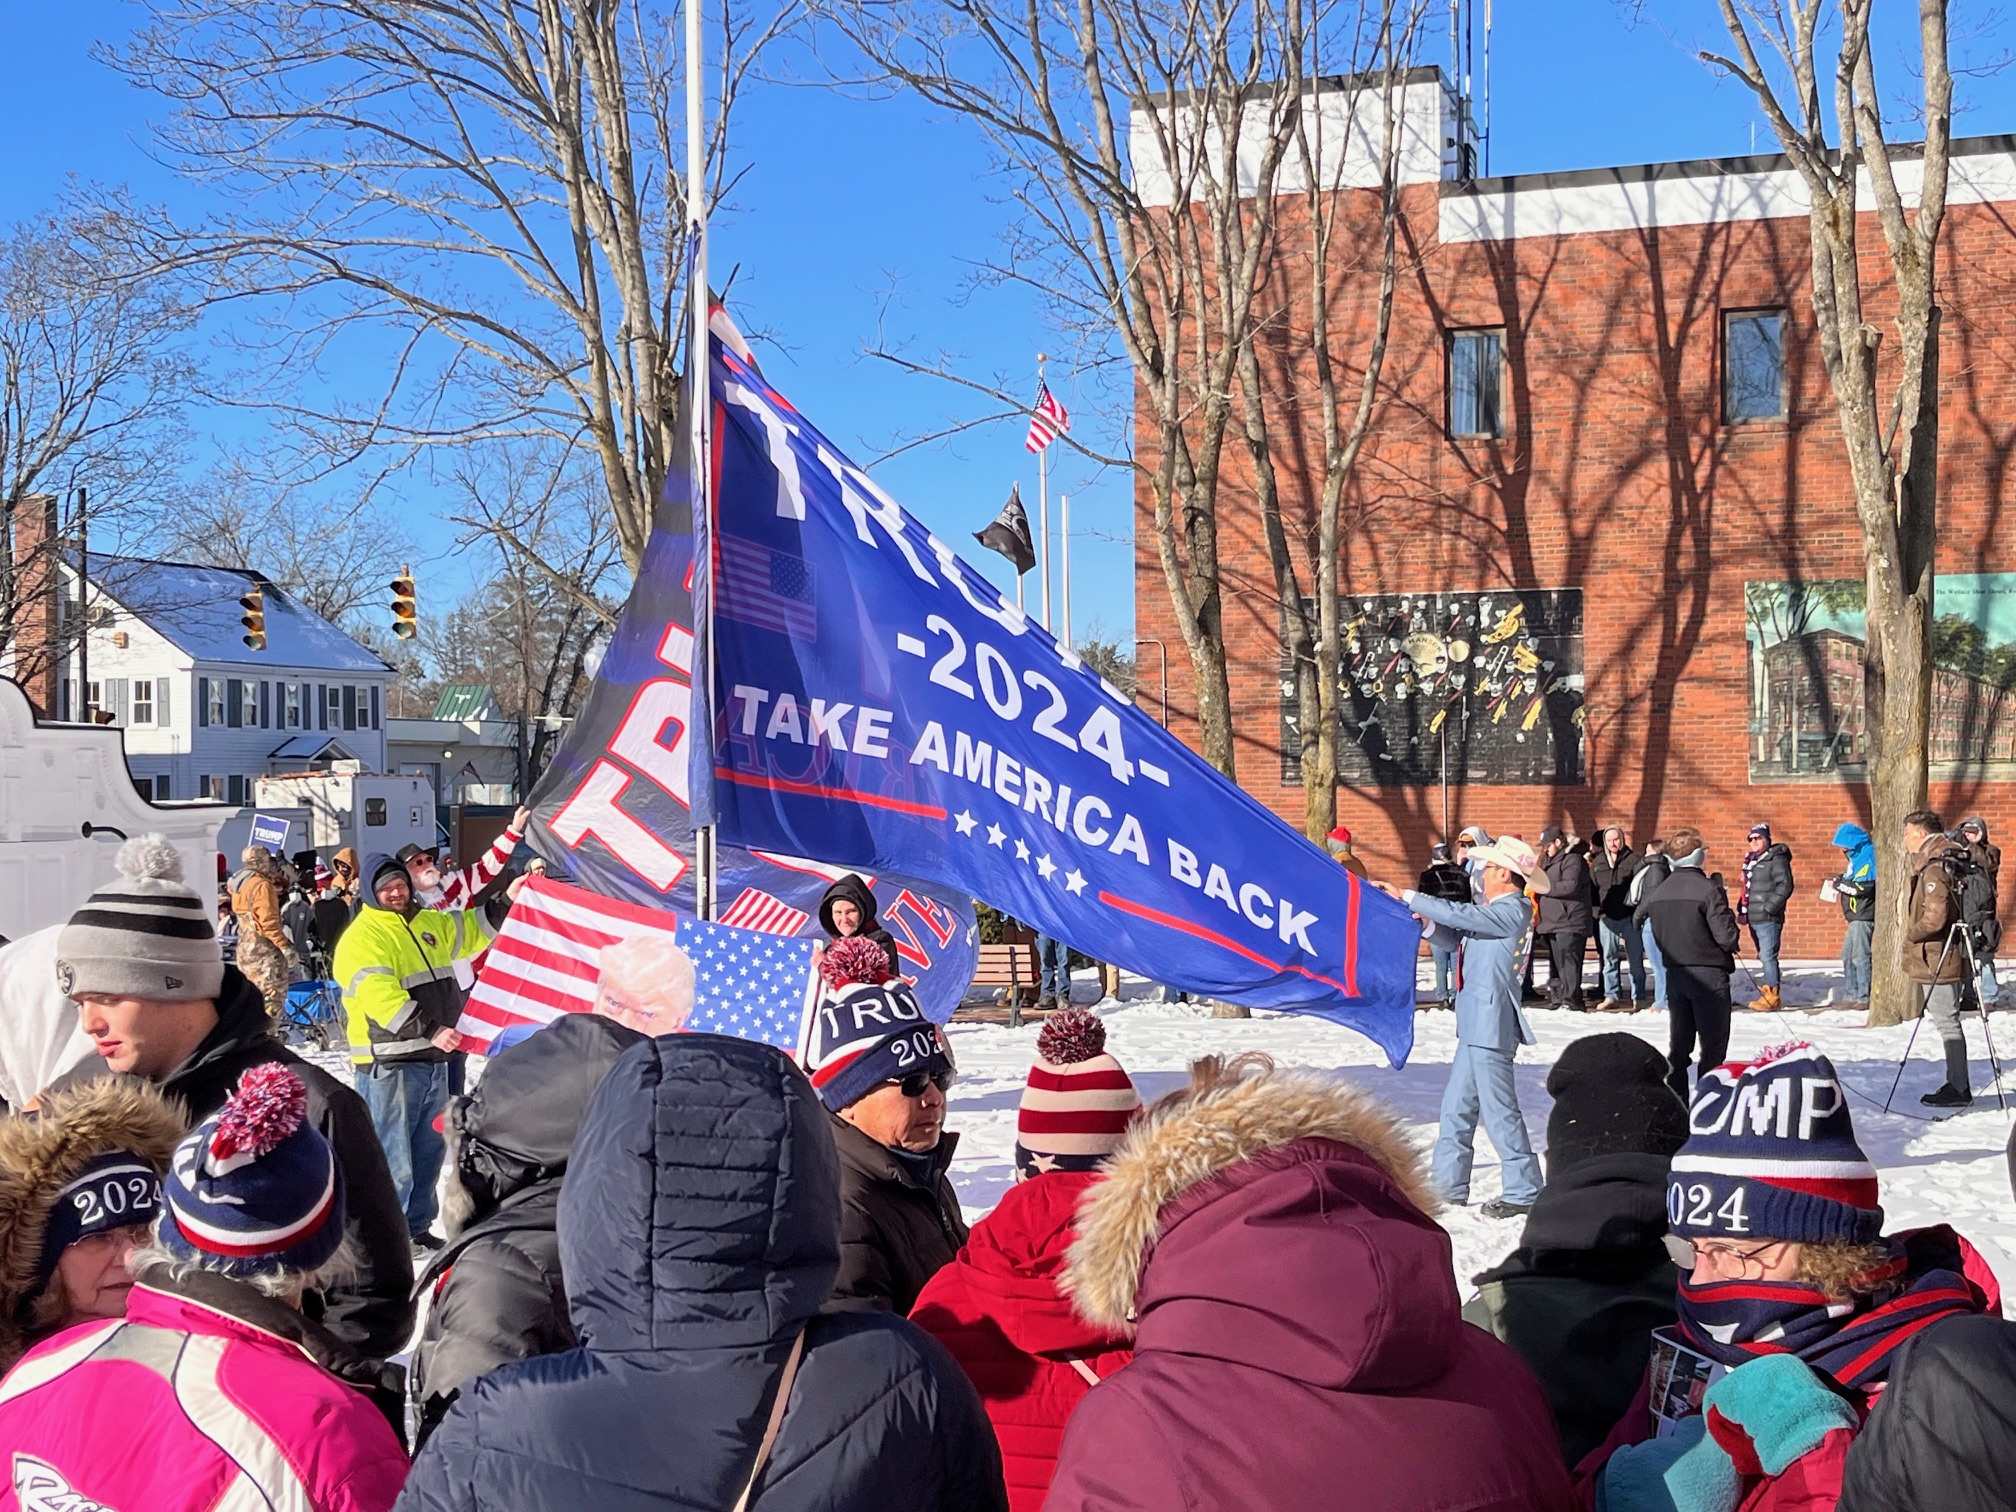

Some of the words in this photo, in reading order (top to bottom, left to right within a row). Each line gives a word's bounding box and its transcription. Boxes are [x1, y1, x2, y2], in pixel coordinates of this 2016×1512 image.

[254, 827, 284, 842] TRUMP
[734, 684, 894, 760] TAKE
[908, 720, 1151, 866] AMERICA
[1166, 837, 1320, 957] BACK
[1689, 1077, 1843, 1140] UMP
[1666, 1181, 1750, 1232] 024
